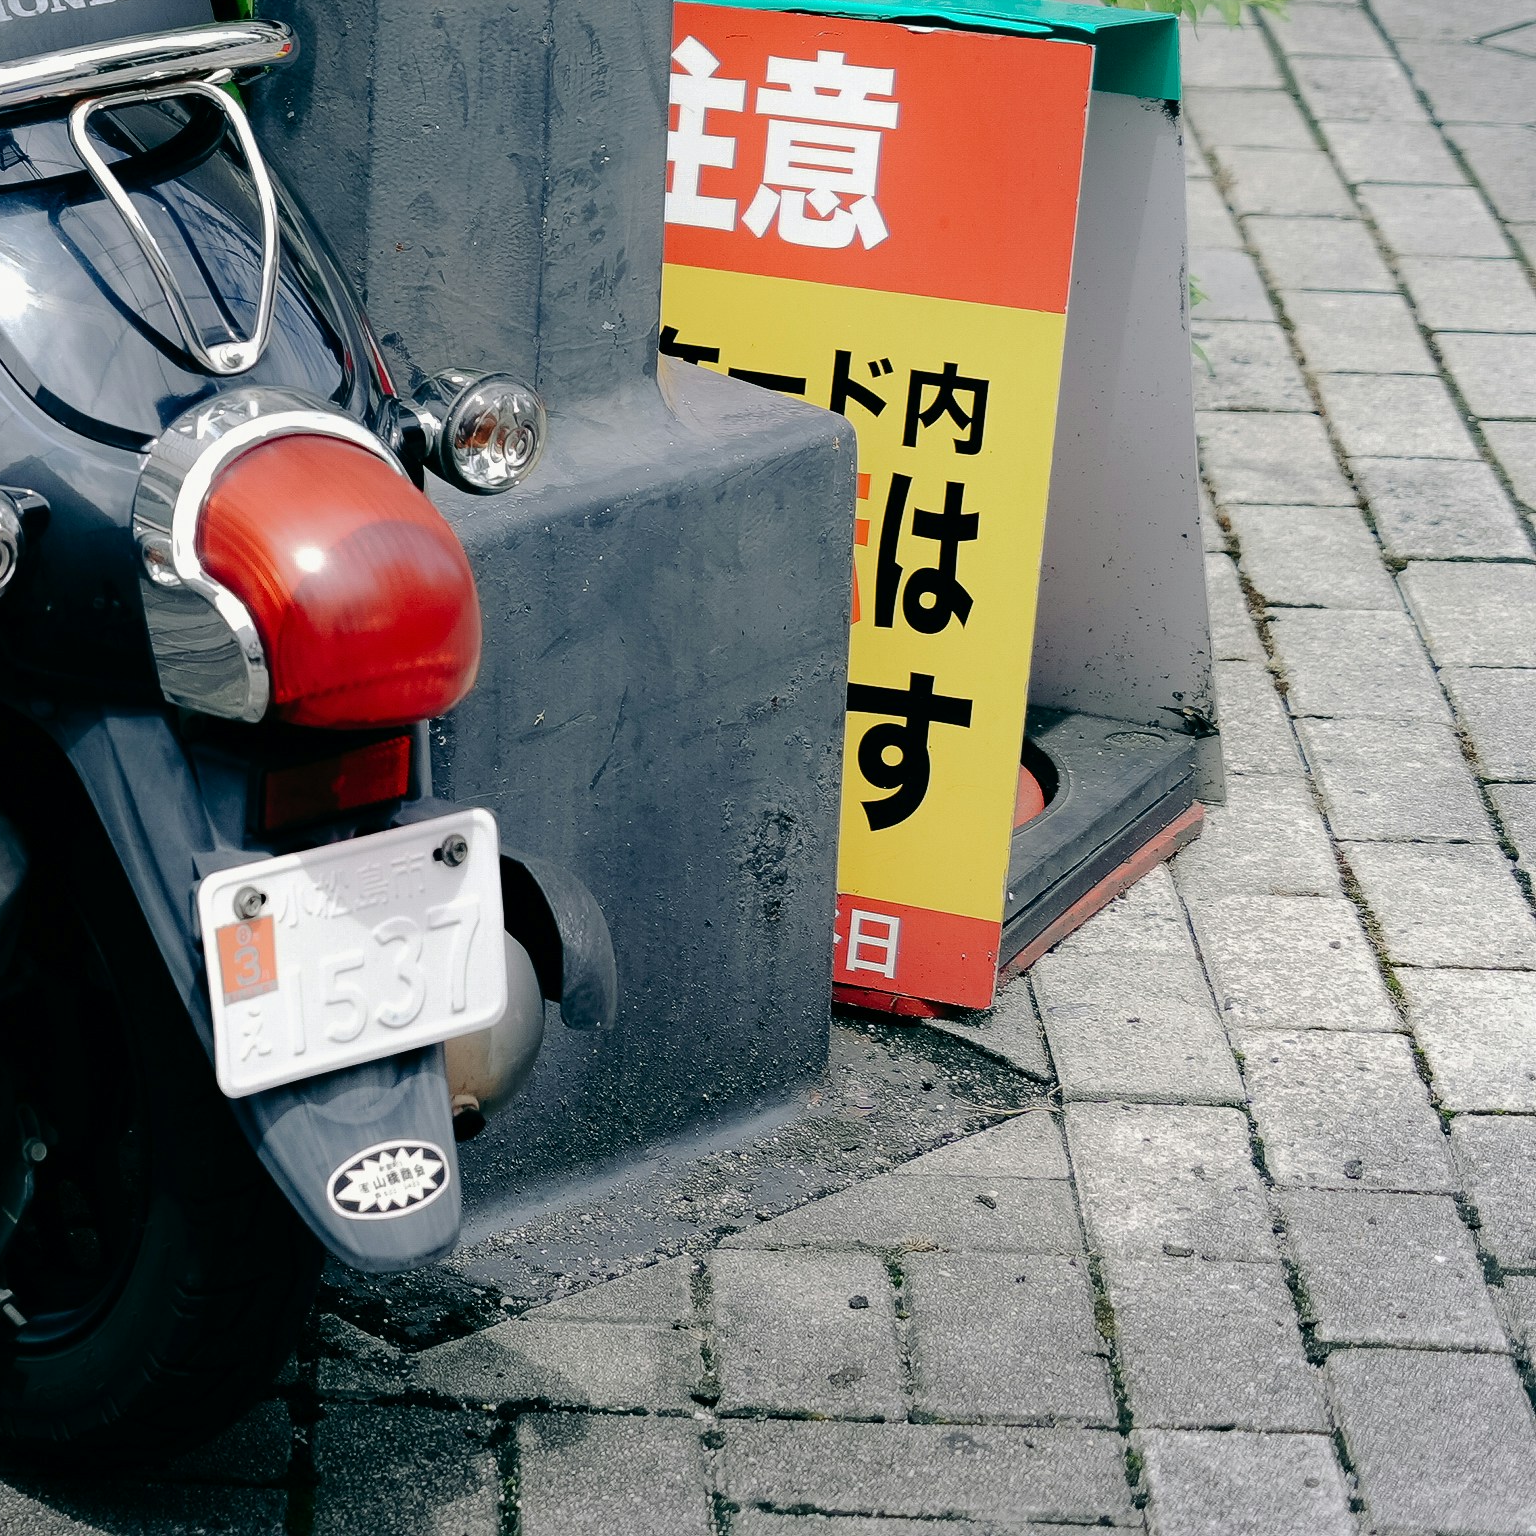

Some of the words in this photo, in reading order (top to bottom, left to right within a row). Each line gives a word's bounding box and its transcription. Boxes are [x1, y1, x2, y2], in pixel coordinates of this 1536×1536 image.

[847, 671, 974, 833] す
[277, 849, 427, 929] 小松島市
[233, 945, 261, 986] 3
[283, 893, 483, 1057] 1537
[833, 907, 902, 980] 日
